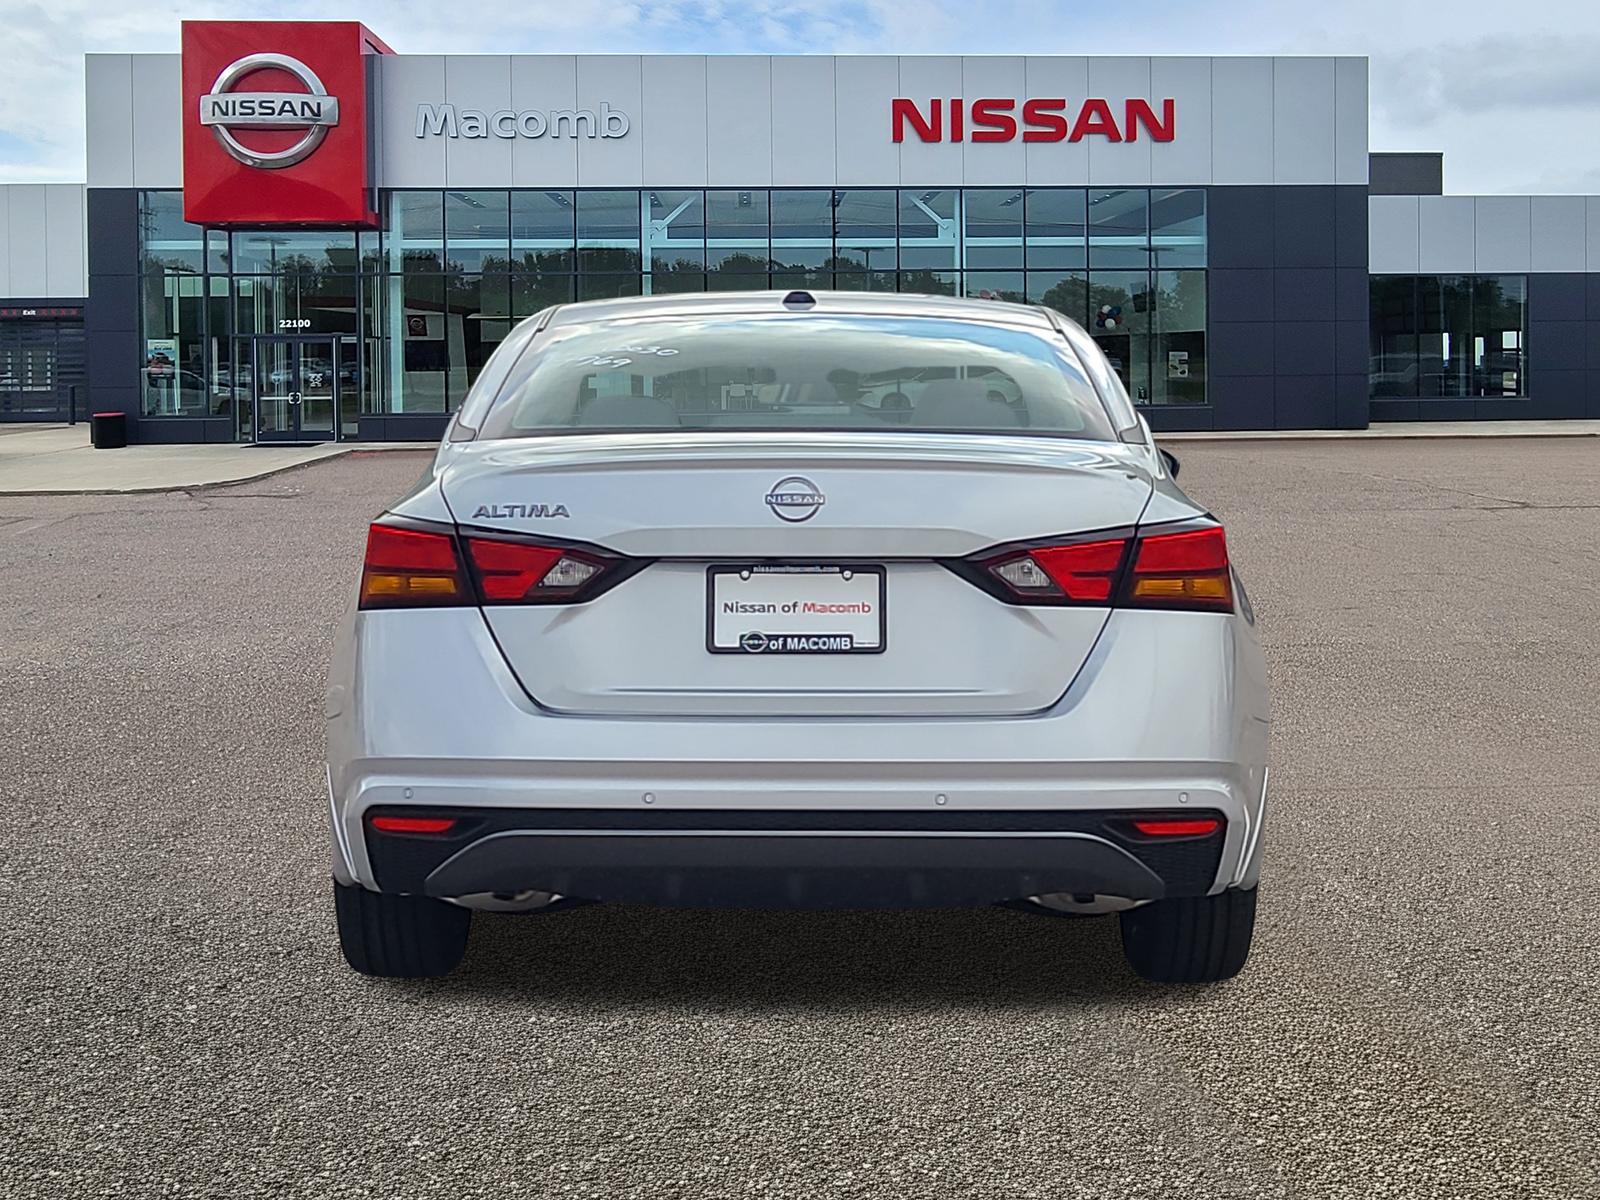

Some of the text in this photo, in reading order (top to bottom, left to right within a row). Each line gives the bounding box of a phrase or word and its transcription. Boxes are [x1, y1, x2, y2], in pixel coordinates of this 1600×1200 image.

[211, 99, 323, 119] NISSAN
[415, 102, 631, 139] Macomb
[892, 98, 1175, 143] NISSAN
[279, 319, 311, 328] 22100
[766, 494, 825, 506] NISSAN
[472, 503, 571, 519] ALTIMA
[723, 601, 871, 614] Nissan of Macomb
[769, 637, 851, 650] of MACOMB
